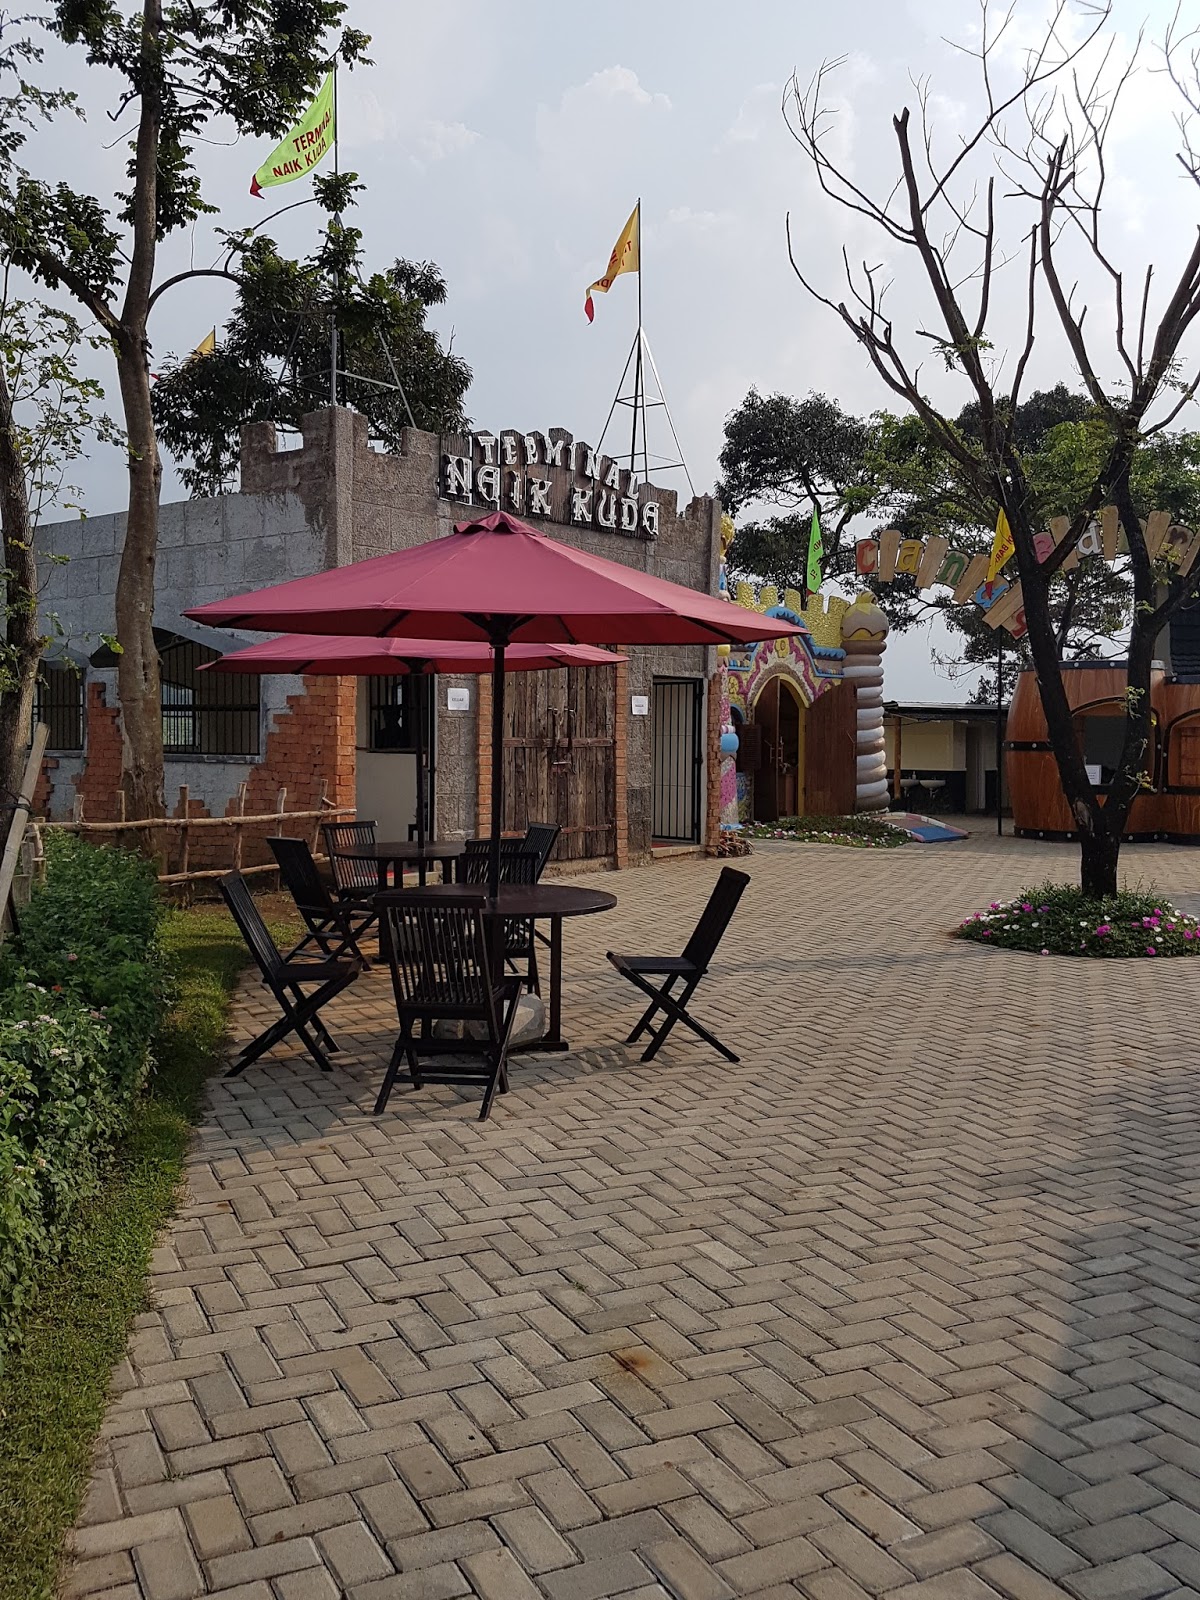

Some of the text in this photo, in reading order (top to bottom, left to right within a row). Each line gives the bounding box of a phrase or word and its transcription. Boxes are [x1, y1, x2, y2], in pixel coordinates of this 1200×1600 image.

[272, 158, 303, 178] NAIK
[443, 453, 660, 536] NAIK KUDA
[477, 435, 640, 500] TERMINAL
